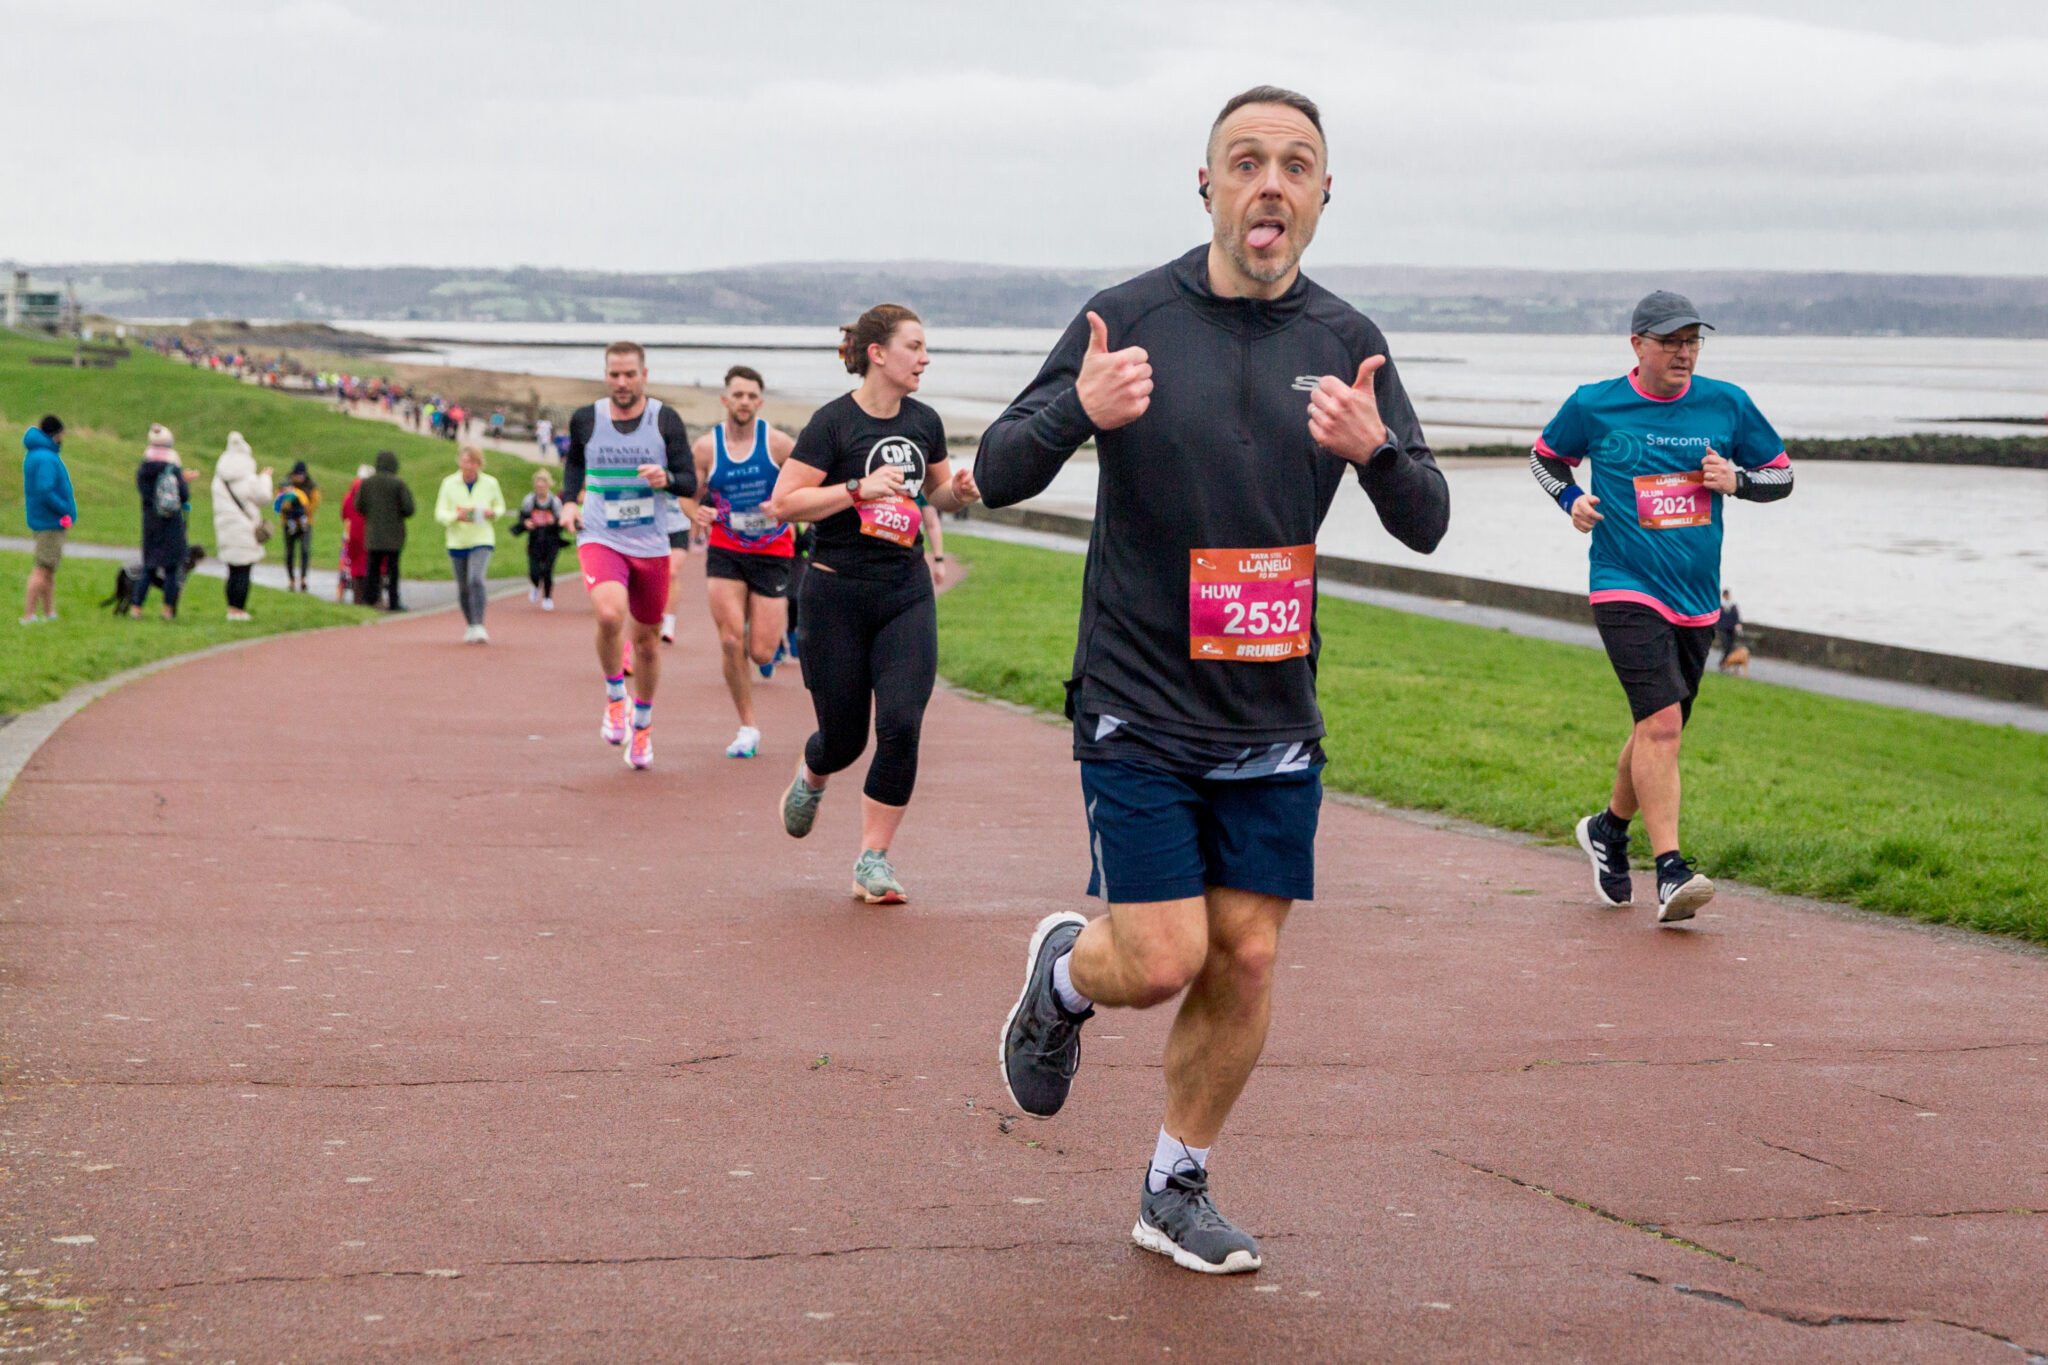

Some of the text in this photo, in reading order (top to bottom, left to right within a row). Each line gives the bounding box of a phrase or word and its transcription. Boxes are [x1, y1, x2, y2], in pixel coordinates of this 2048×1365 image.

[1646, 433, 1710, 447] Sarcoma
[881, 444, 912, 464] CDF
[1652, 495, 1696, 515] 2021
[874, 508, 910, 532] 2263
[1238, 557, 1292, 573] LLANELLI
[1201, 584, 1242, 599] HUW
[1223, 599, 1300, 635] 2532
